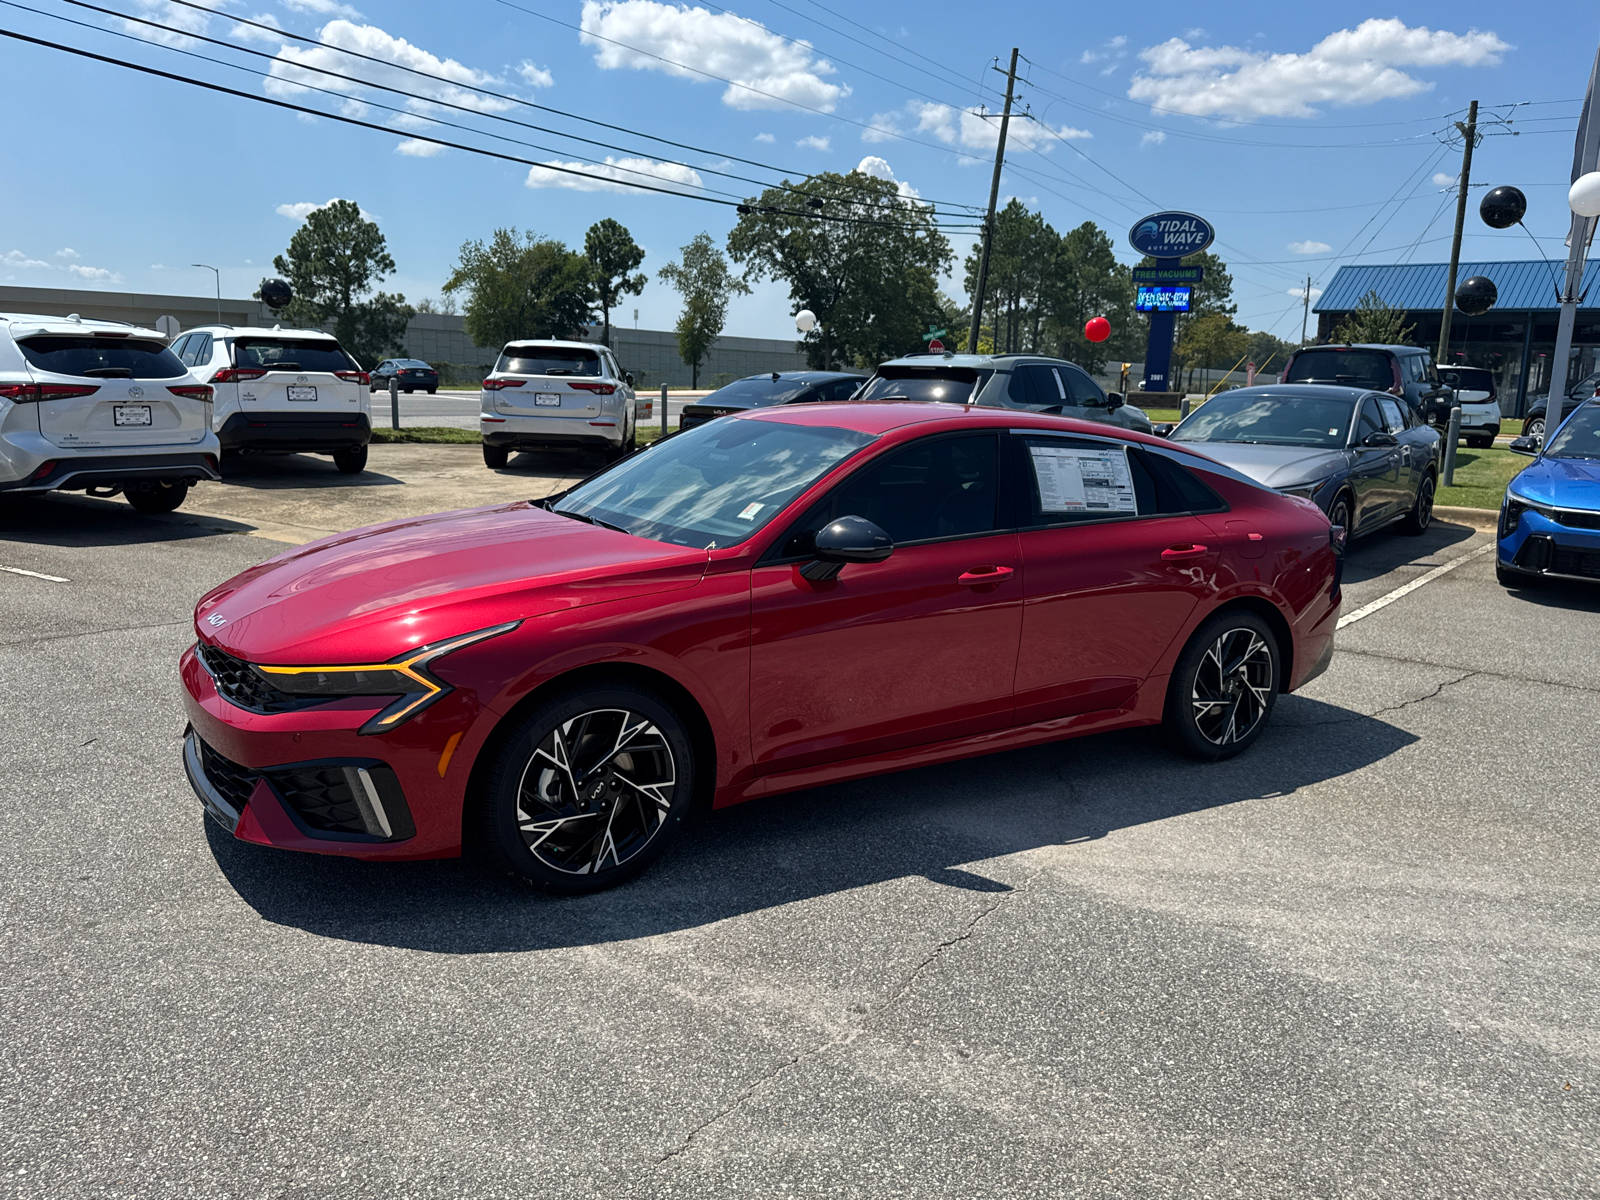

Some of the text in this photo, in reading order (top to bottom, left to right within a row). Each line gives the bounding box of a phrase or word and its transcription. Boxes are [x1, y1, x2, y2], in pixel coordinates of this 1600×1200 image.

[1158, 220, 1197, 232] TIDAL
[1163, 232, 1205, 244] WAVE
[1135, 269, 1197, 279] FREE VACUUMS
[206, 611, 227, 629] KIA
